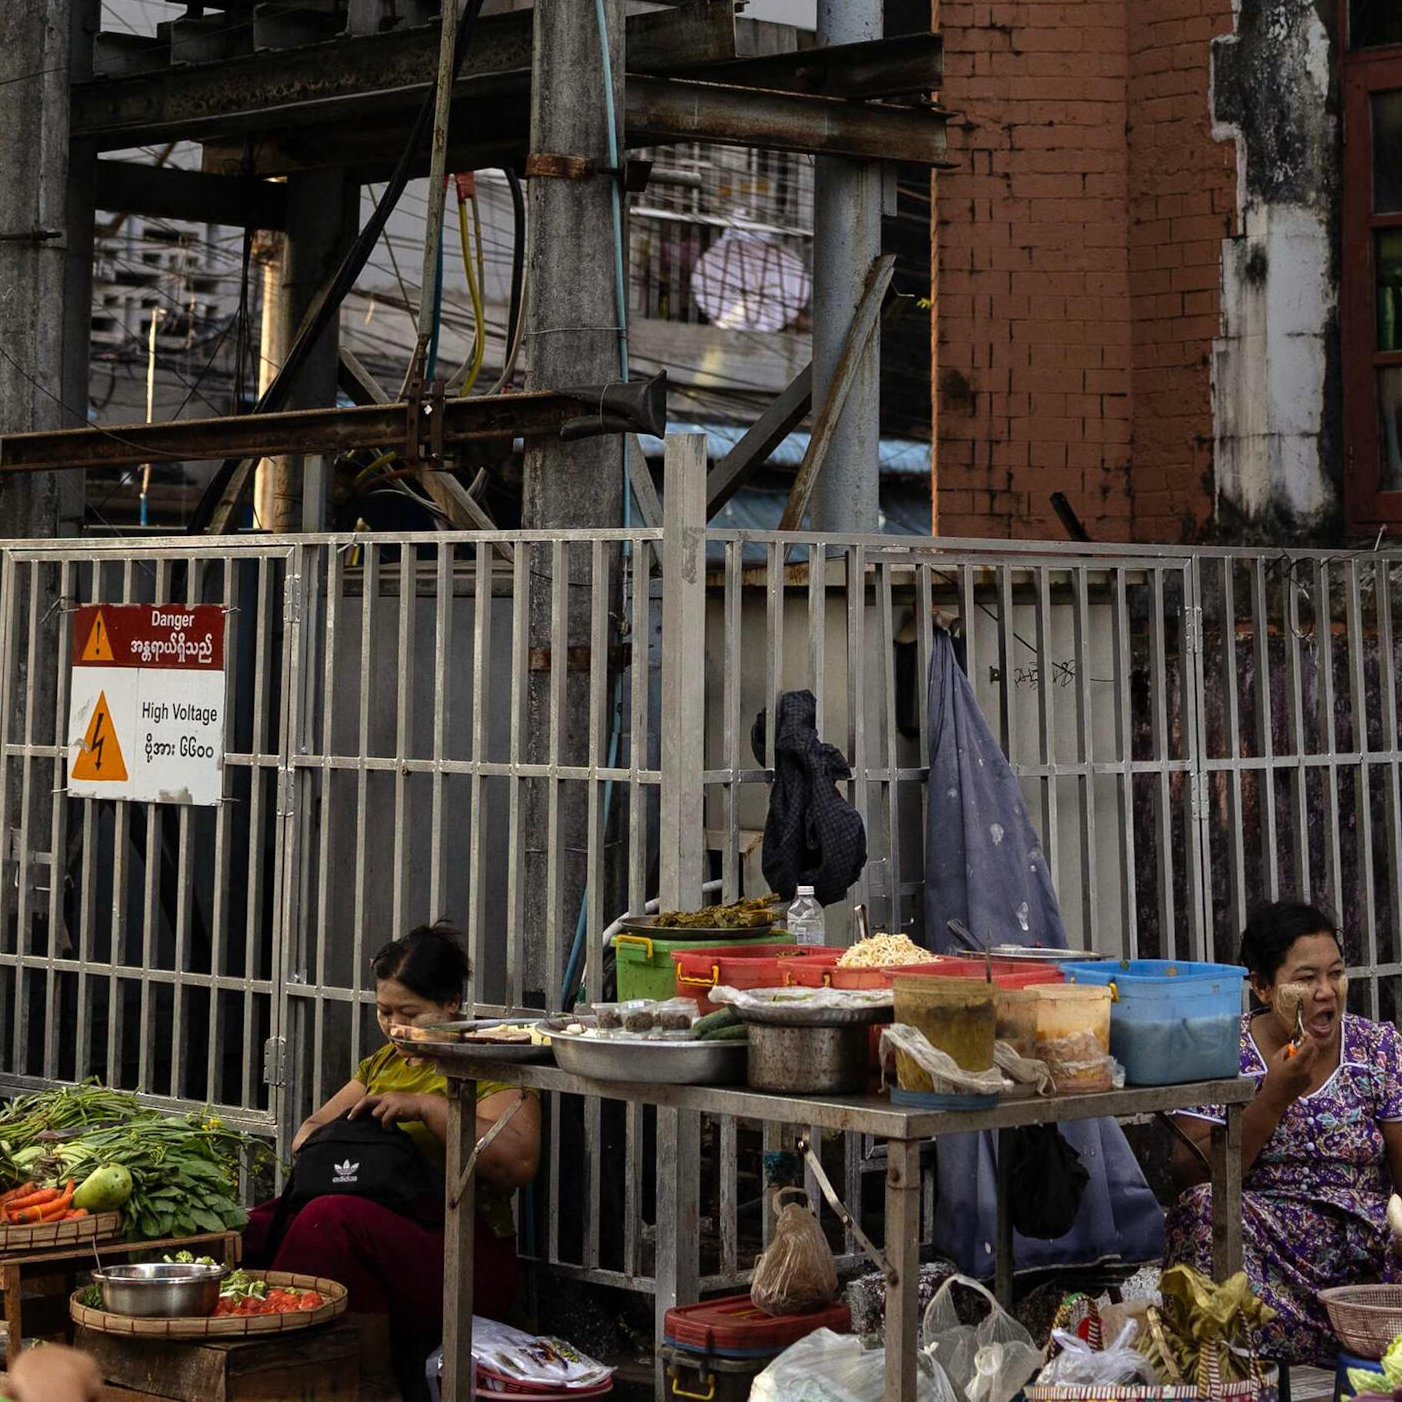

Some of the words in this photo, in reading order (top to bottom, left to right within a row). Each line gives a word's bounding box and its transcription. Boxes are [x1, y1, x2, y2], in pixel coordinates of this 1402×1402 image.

[151, 610, 195, 631] Danger
[130, 632, 213, 663] အန္တရာယ်ရှိသည်
[142, 702, 169, 724] High
[172, 703, 218, 726] Voltage
[144, 733, 175, 763] ဗို့အား
[179, 735, 214, 759] ၆၆၀၀
[332, 1175, 358, 1184] adidas
